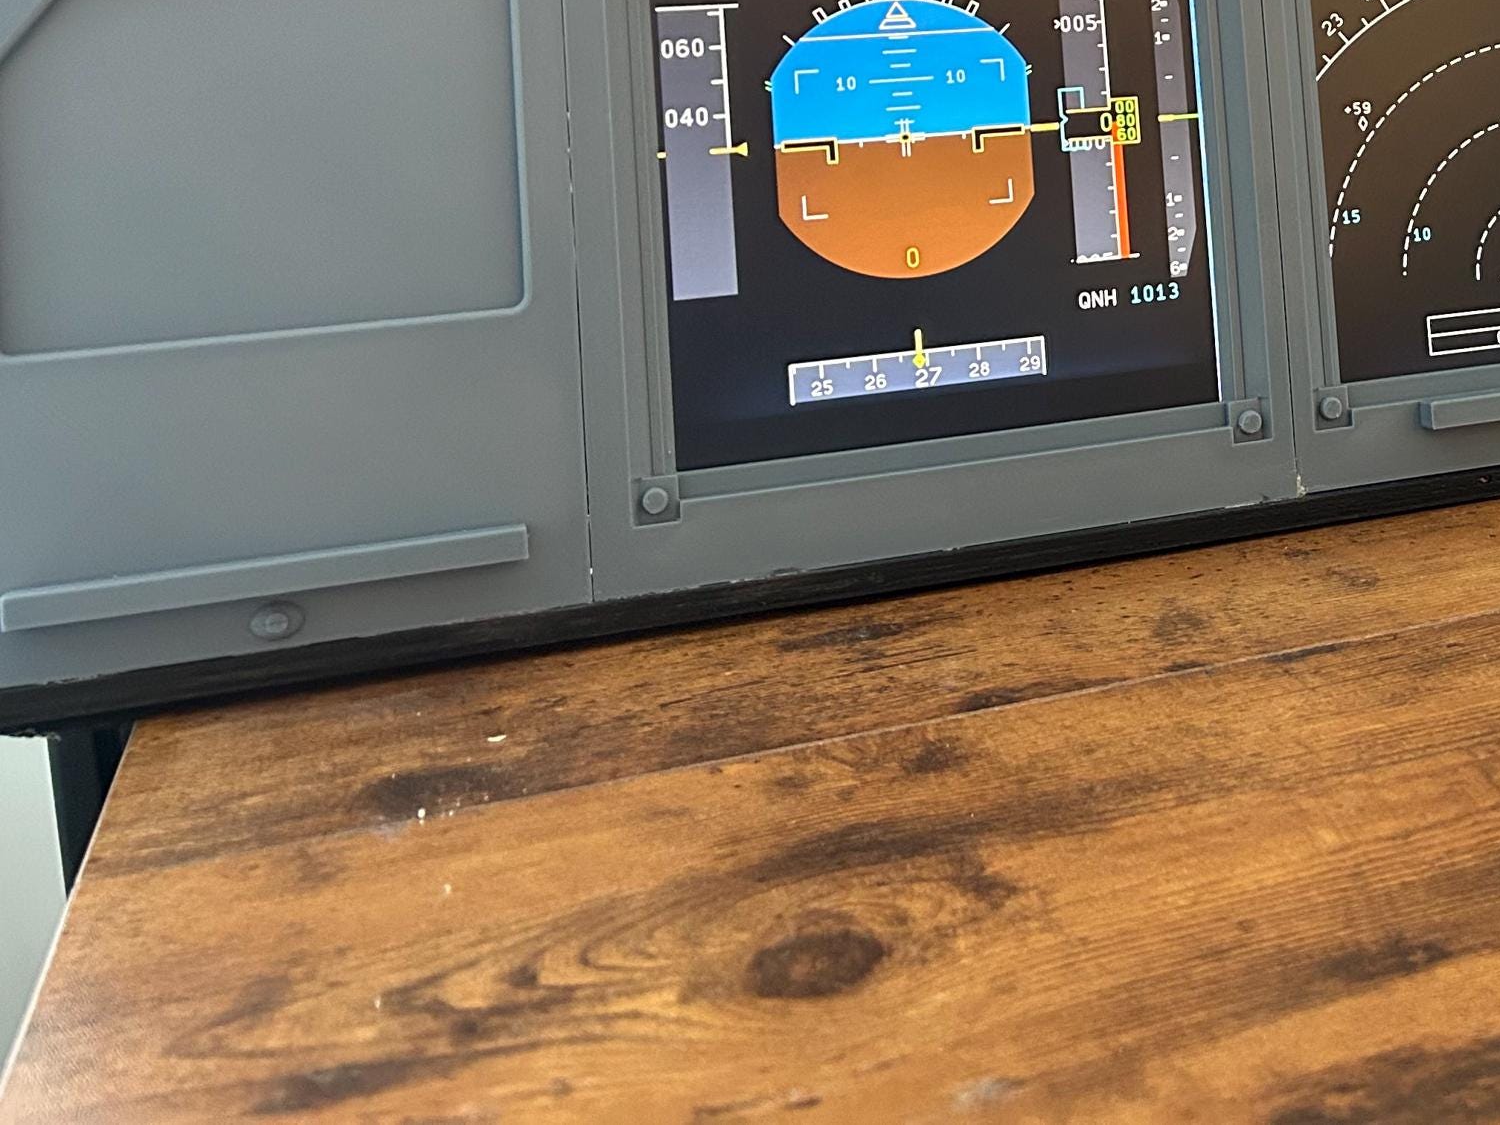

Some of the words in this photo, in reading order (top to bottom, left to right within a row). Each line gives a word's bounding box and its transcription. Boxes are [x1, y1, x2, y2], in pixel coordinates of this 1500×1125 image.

[1322, 13, 1344, 36] 23
[661, 38, 704, 59] 060
[836, 76, 856, 91] 10
[946, 69, 966, 84] 10
[665, 107, 708, 128] 040
[1342, 210, 1360, 224] 15
[1414, 227, 1431, 242] 10
[1079, 289, 1117, 309] QNH
[1131, 283, 1179, 304] 1013
[969, 362, 990, 378] 28
[1020, 356, 1040, 371] 29
[864, 375, 887, 390] 26
[915, 367, 942, 387] 27
[811, 380, 833, 397] 25
